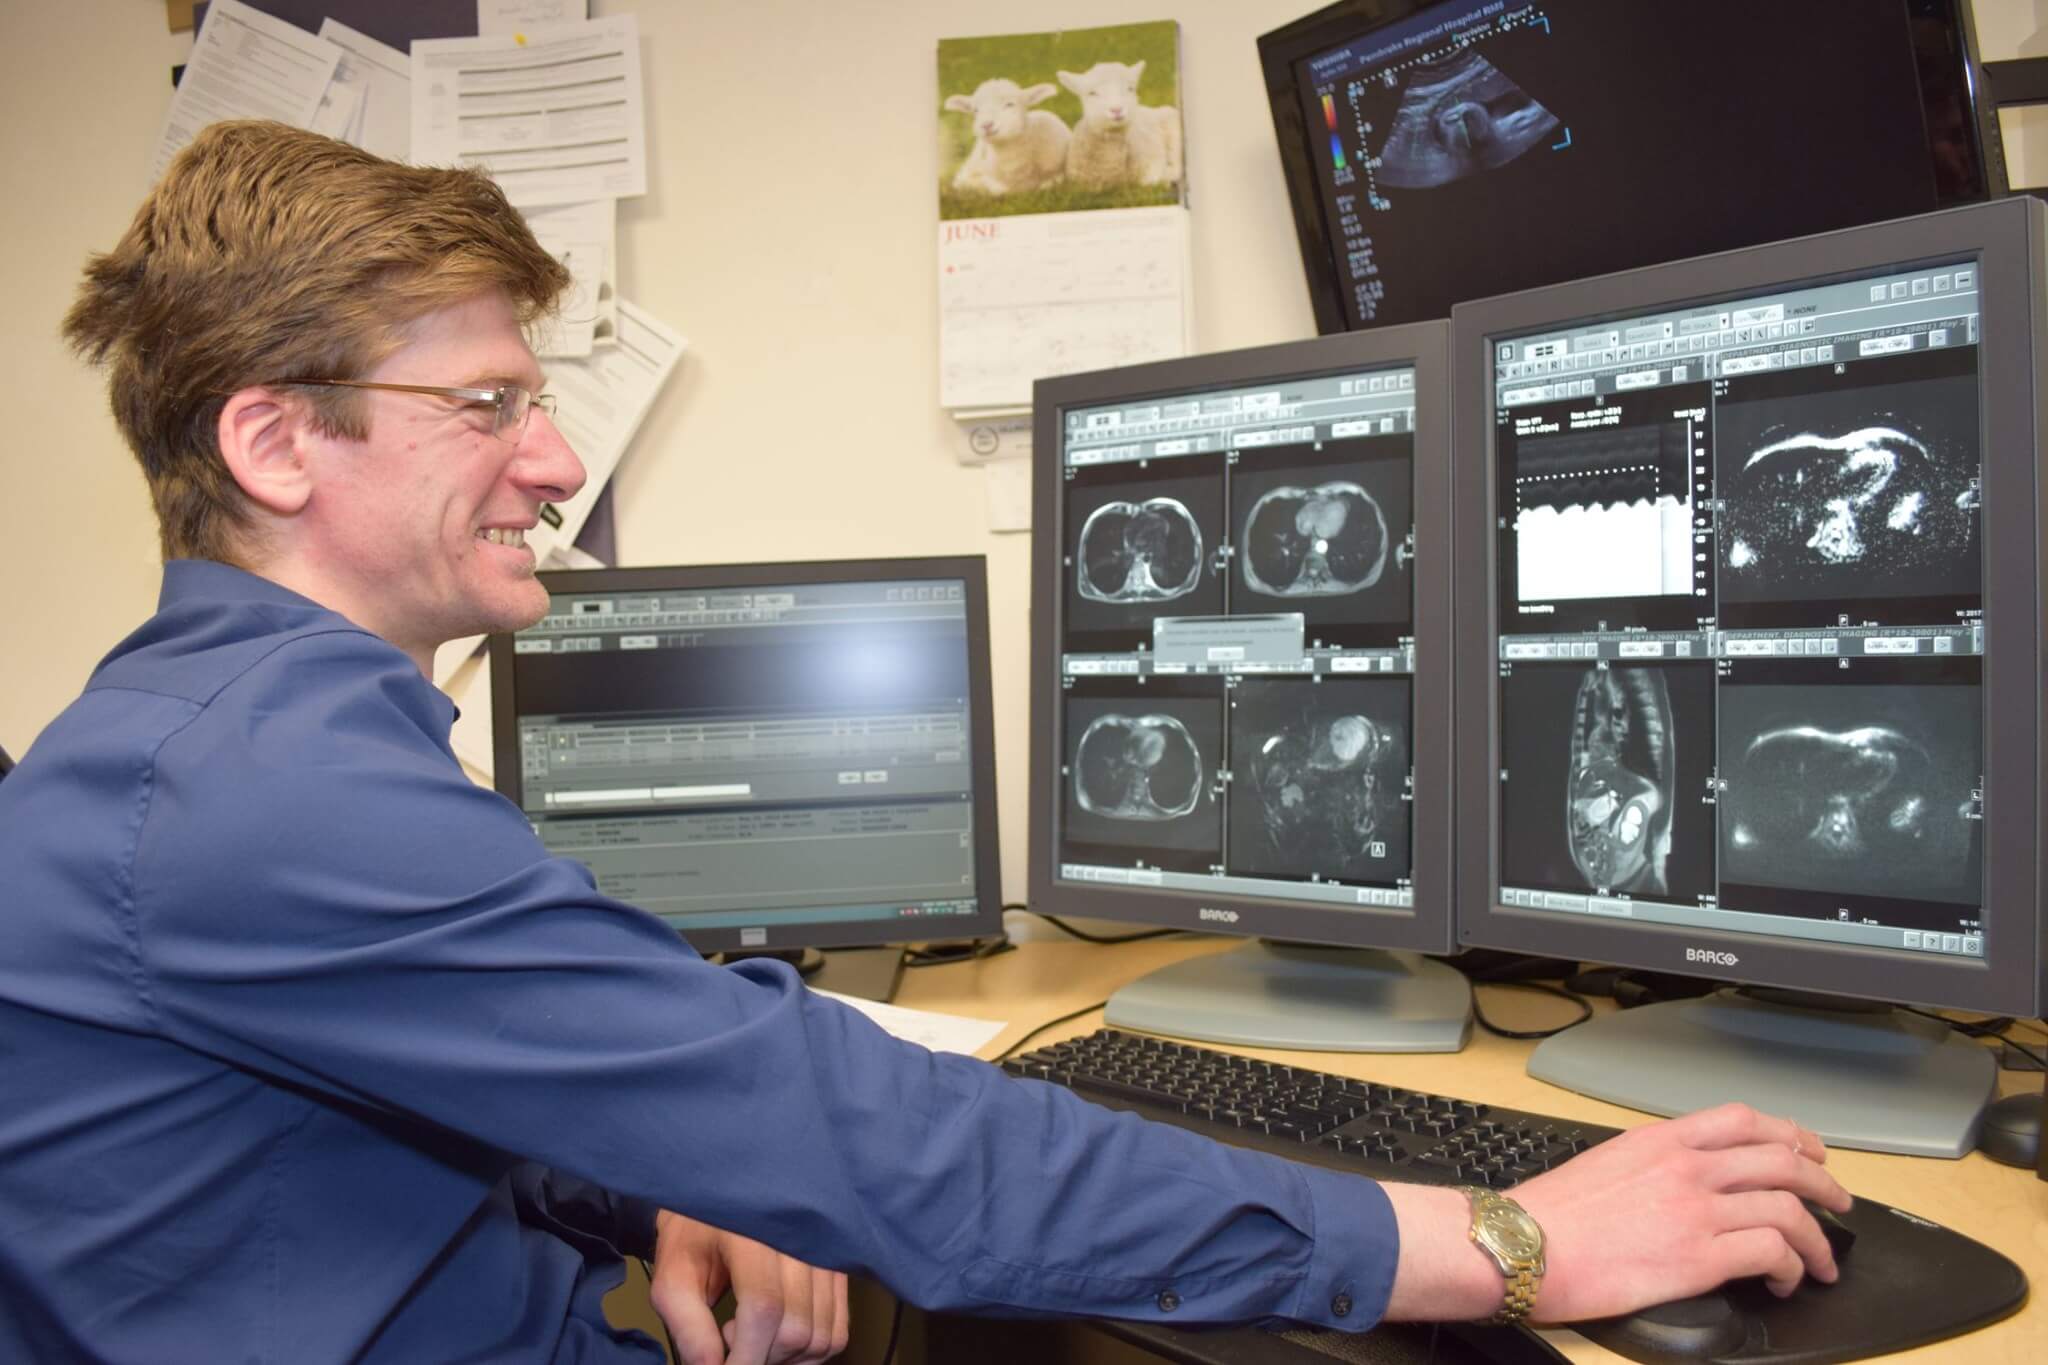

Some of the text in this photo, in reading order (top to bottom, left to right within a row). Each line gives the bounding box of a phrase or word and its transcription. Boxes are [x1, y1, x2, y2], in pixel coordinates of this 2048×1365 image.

[1404, 25, 1443, 48] Regional
[1444, 10, 1482, 32] Hospital
[944, 223, 1000, 244] JUNE
[1793, 305, 1817, 315] NONE
[1686, 948, 1739, 966] BARCO
